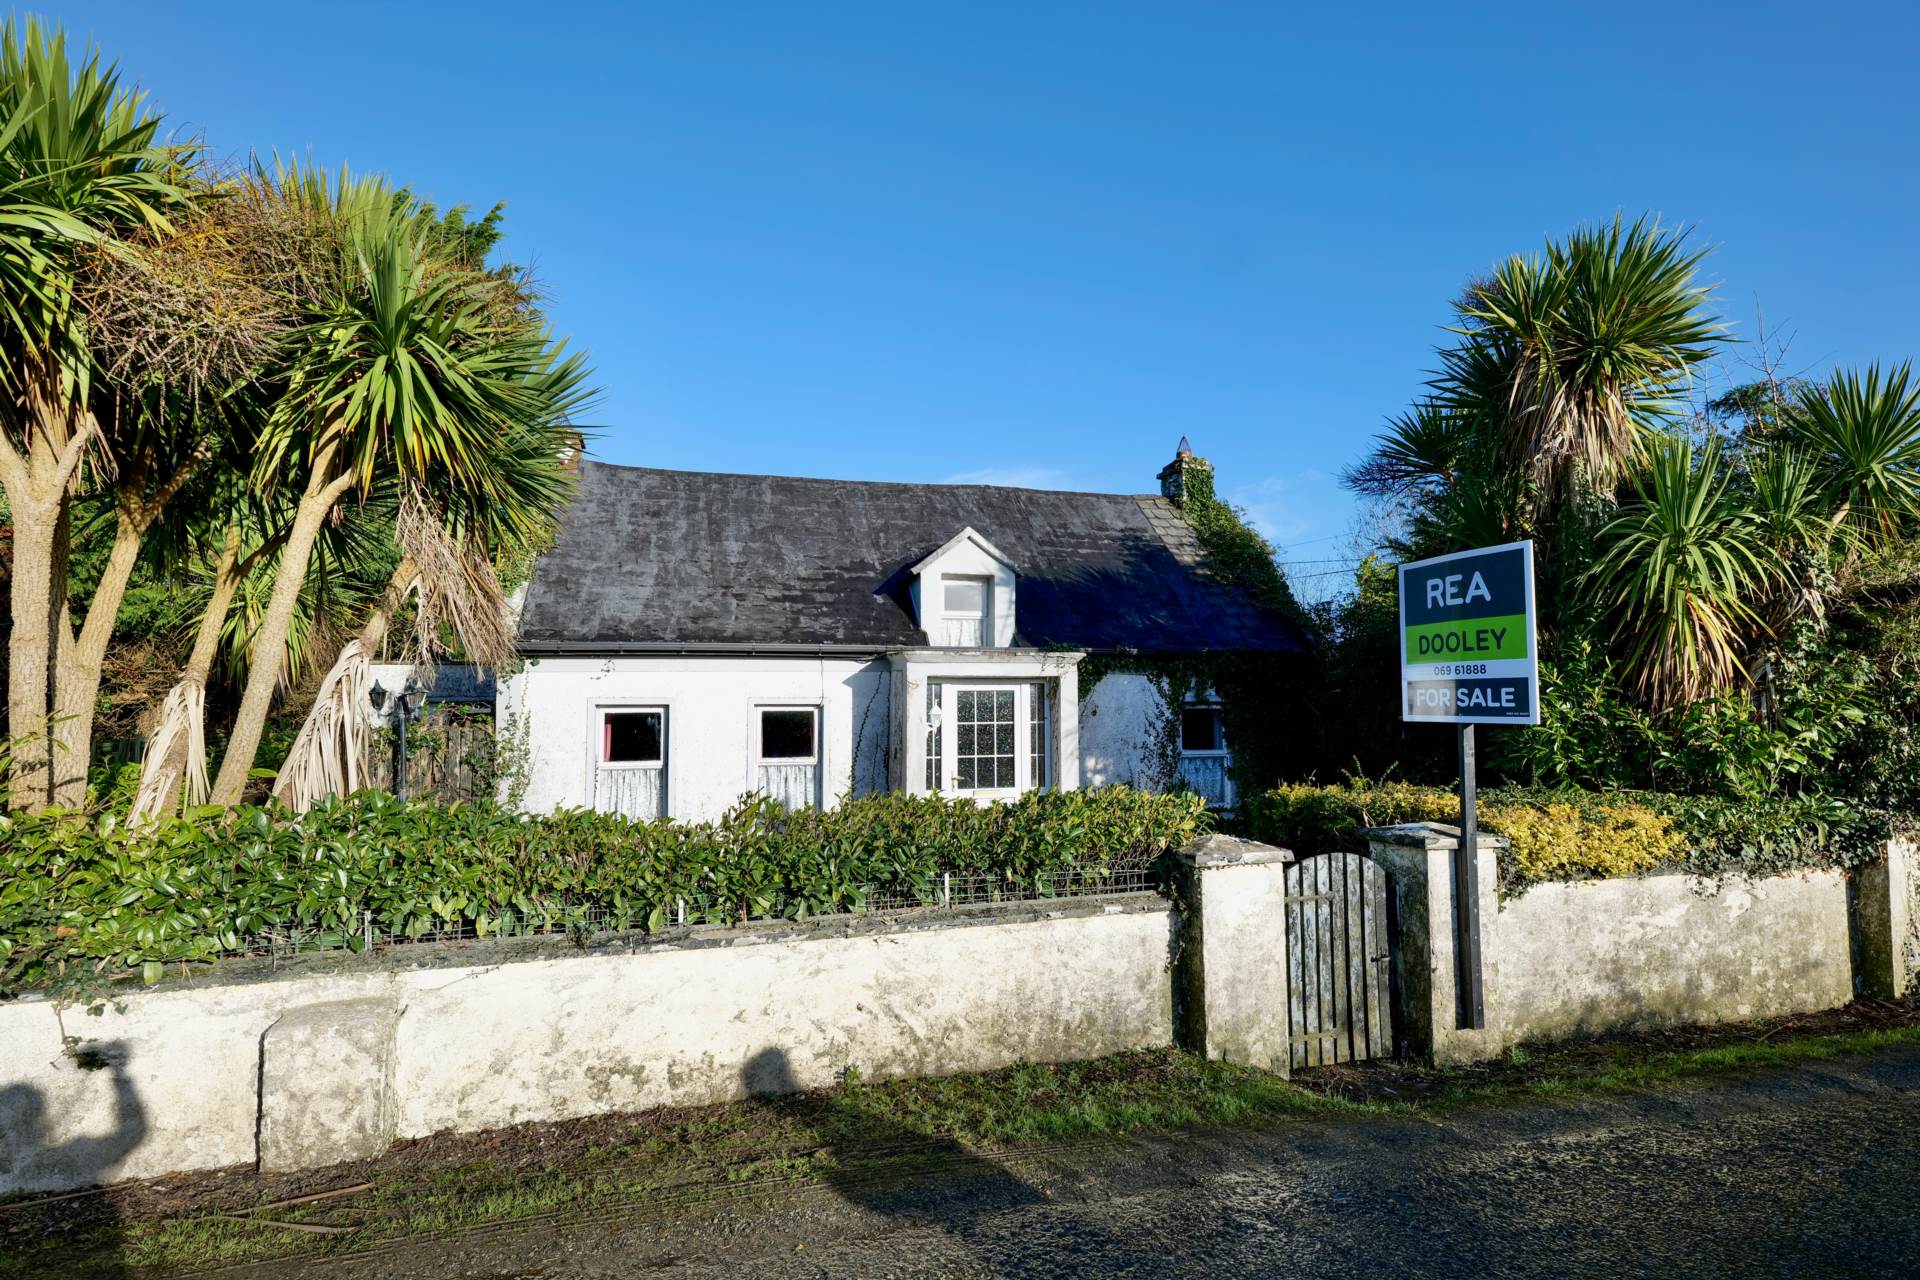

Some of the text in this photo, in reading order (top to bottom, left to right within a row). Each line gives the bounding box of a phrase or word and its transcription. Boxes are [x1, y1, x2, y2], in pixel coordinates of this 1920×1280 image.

[1426, 570, 1491, 609] REA
[1418, 627, 1507, 655] DOOLEY
[1434, 664, 1487, 676] 069 61888
[1416, 687, 1516, 708] FOR SALE
